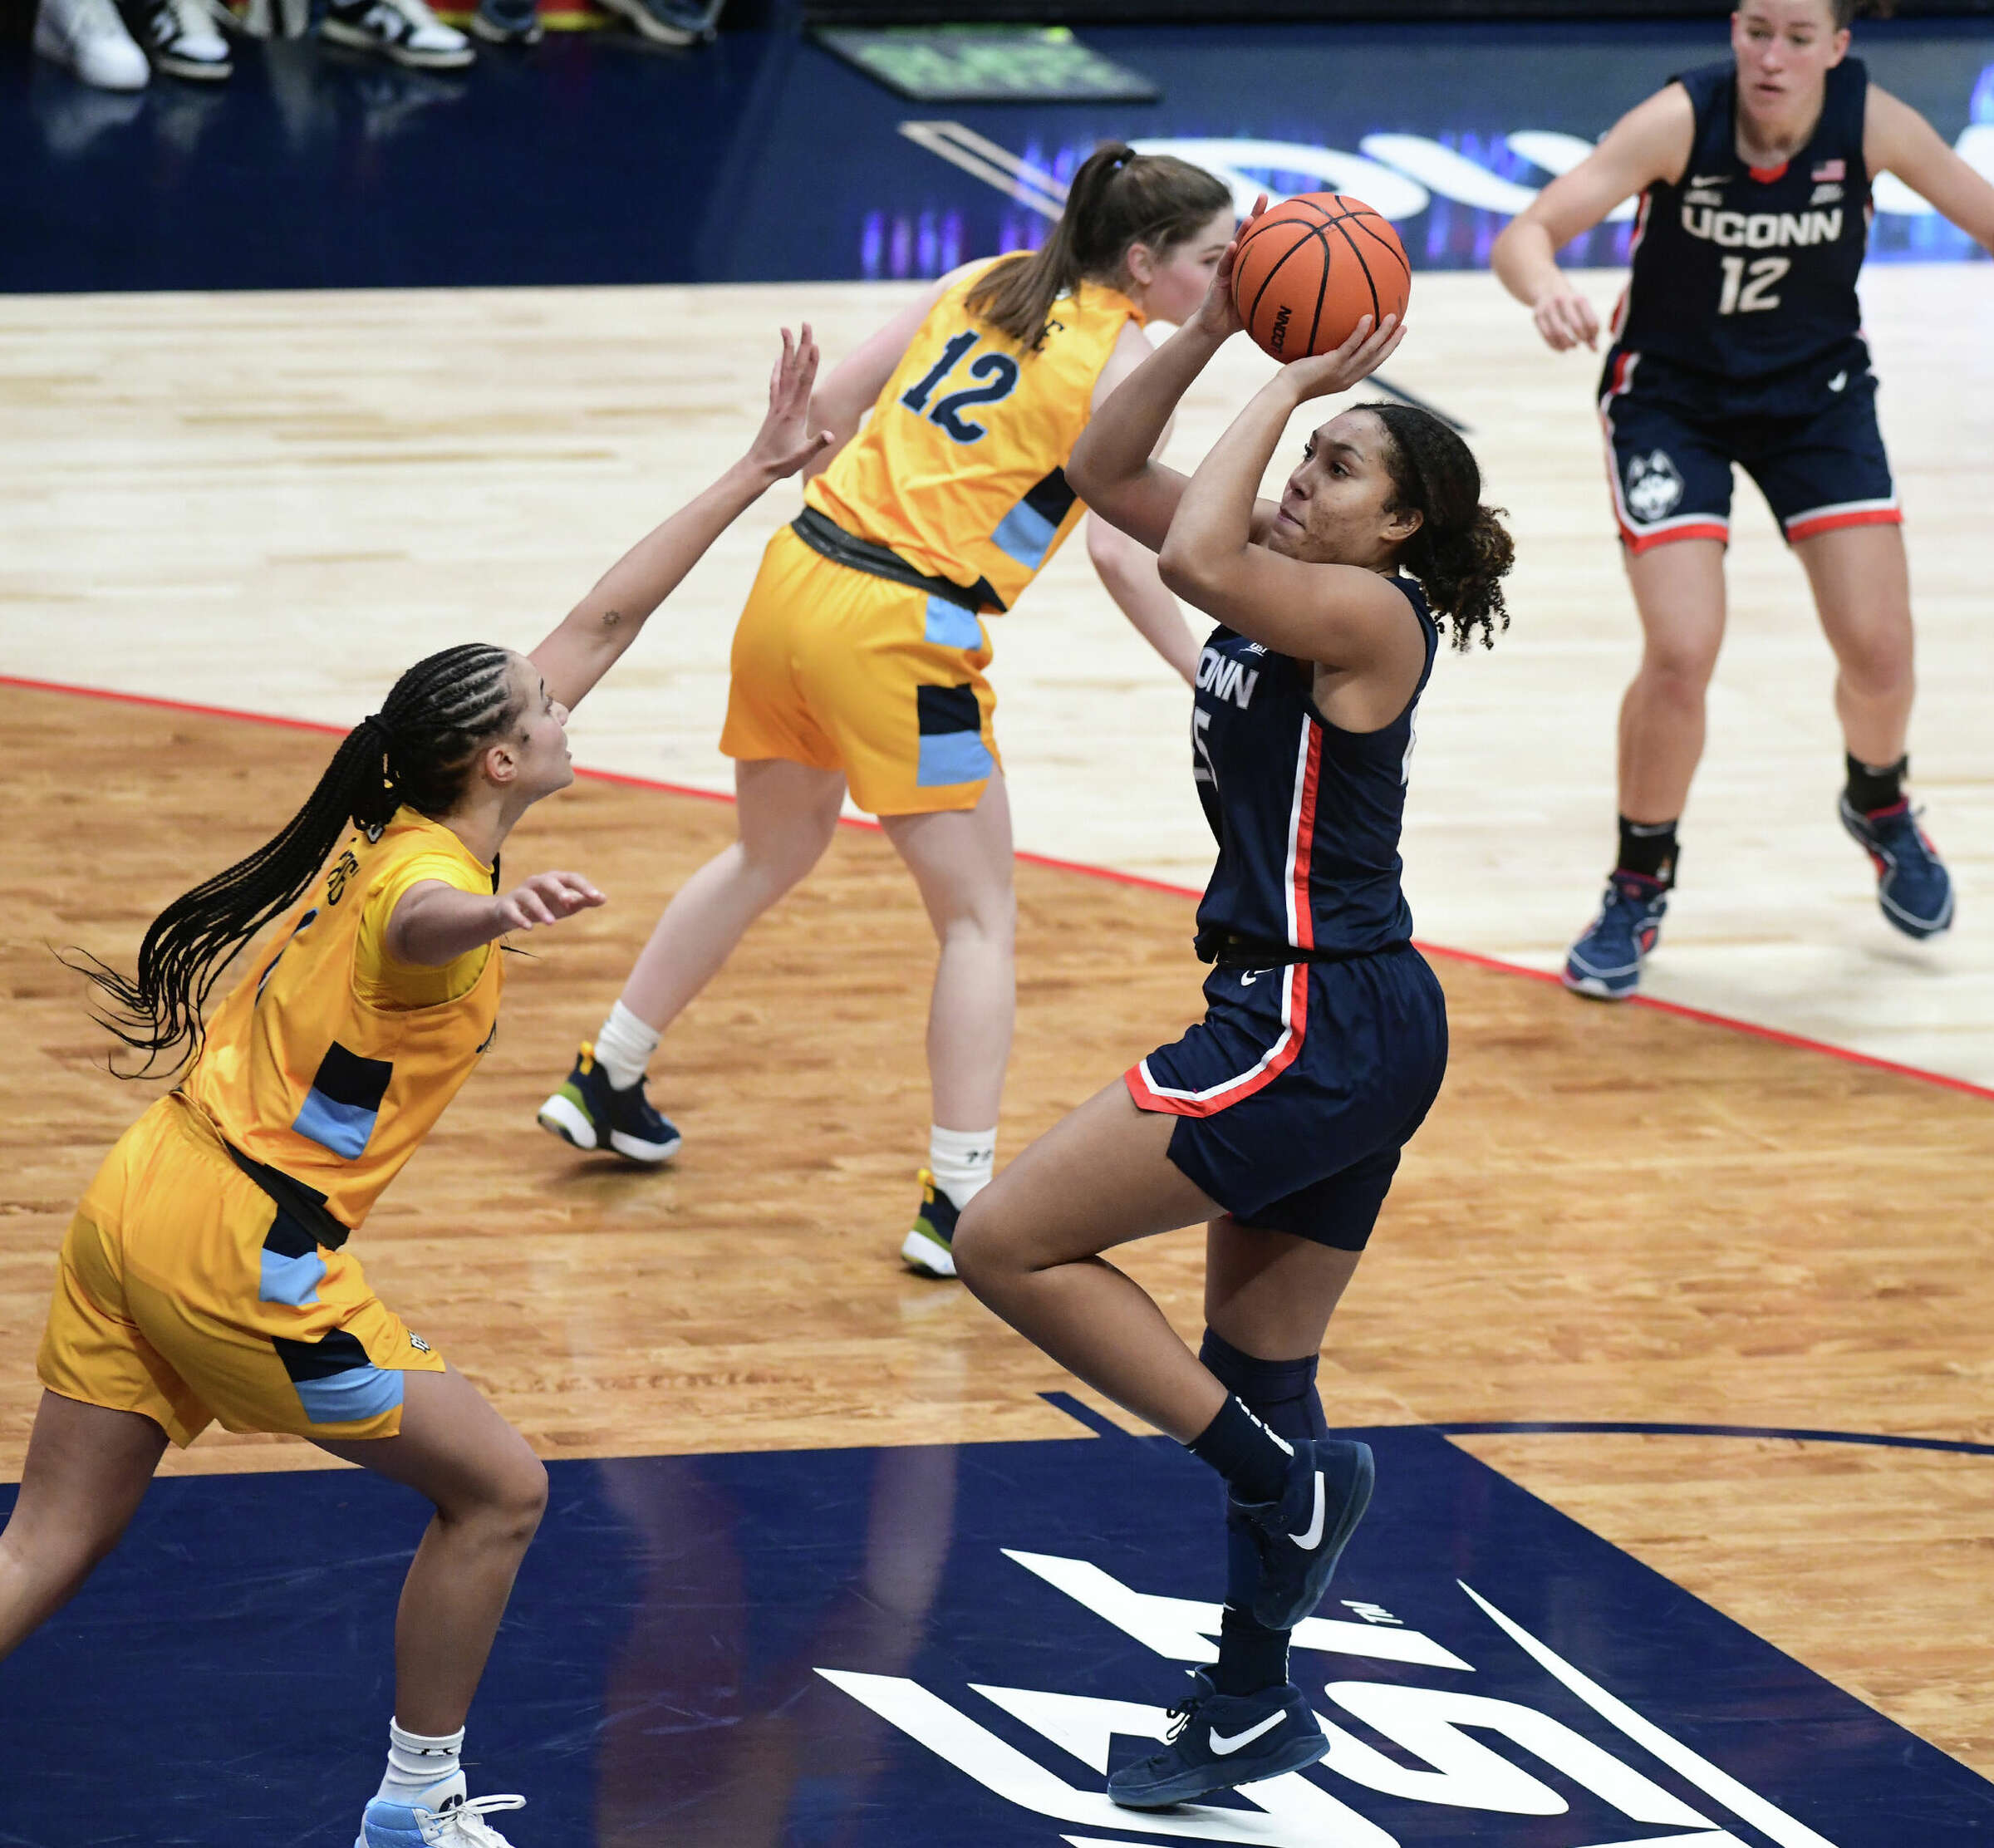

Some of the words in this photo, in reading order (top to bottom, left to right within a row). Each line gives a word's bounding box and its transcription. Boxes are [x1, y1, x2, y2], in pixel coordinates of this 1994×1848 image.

[1682, 205, 1843, 248] UCONN
[1718, 256, 1790, 315] 12
[900, 329, 1019, 445] 12
[1195, 647, 1260, 710] ONN
[1191, 706, 1219, 792] 5
